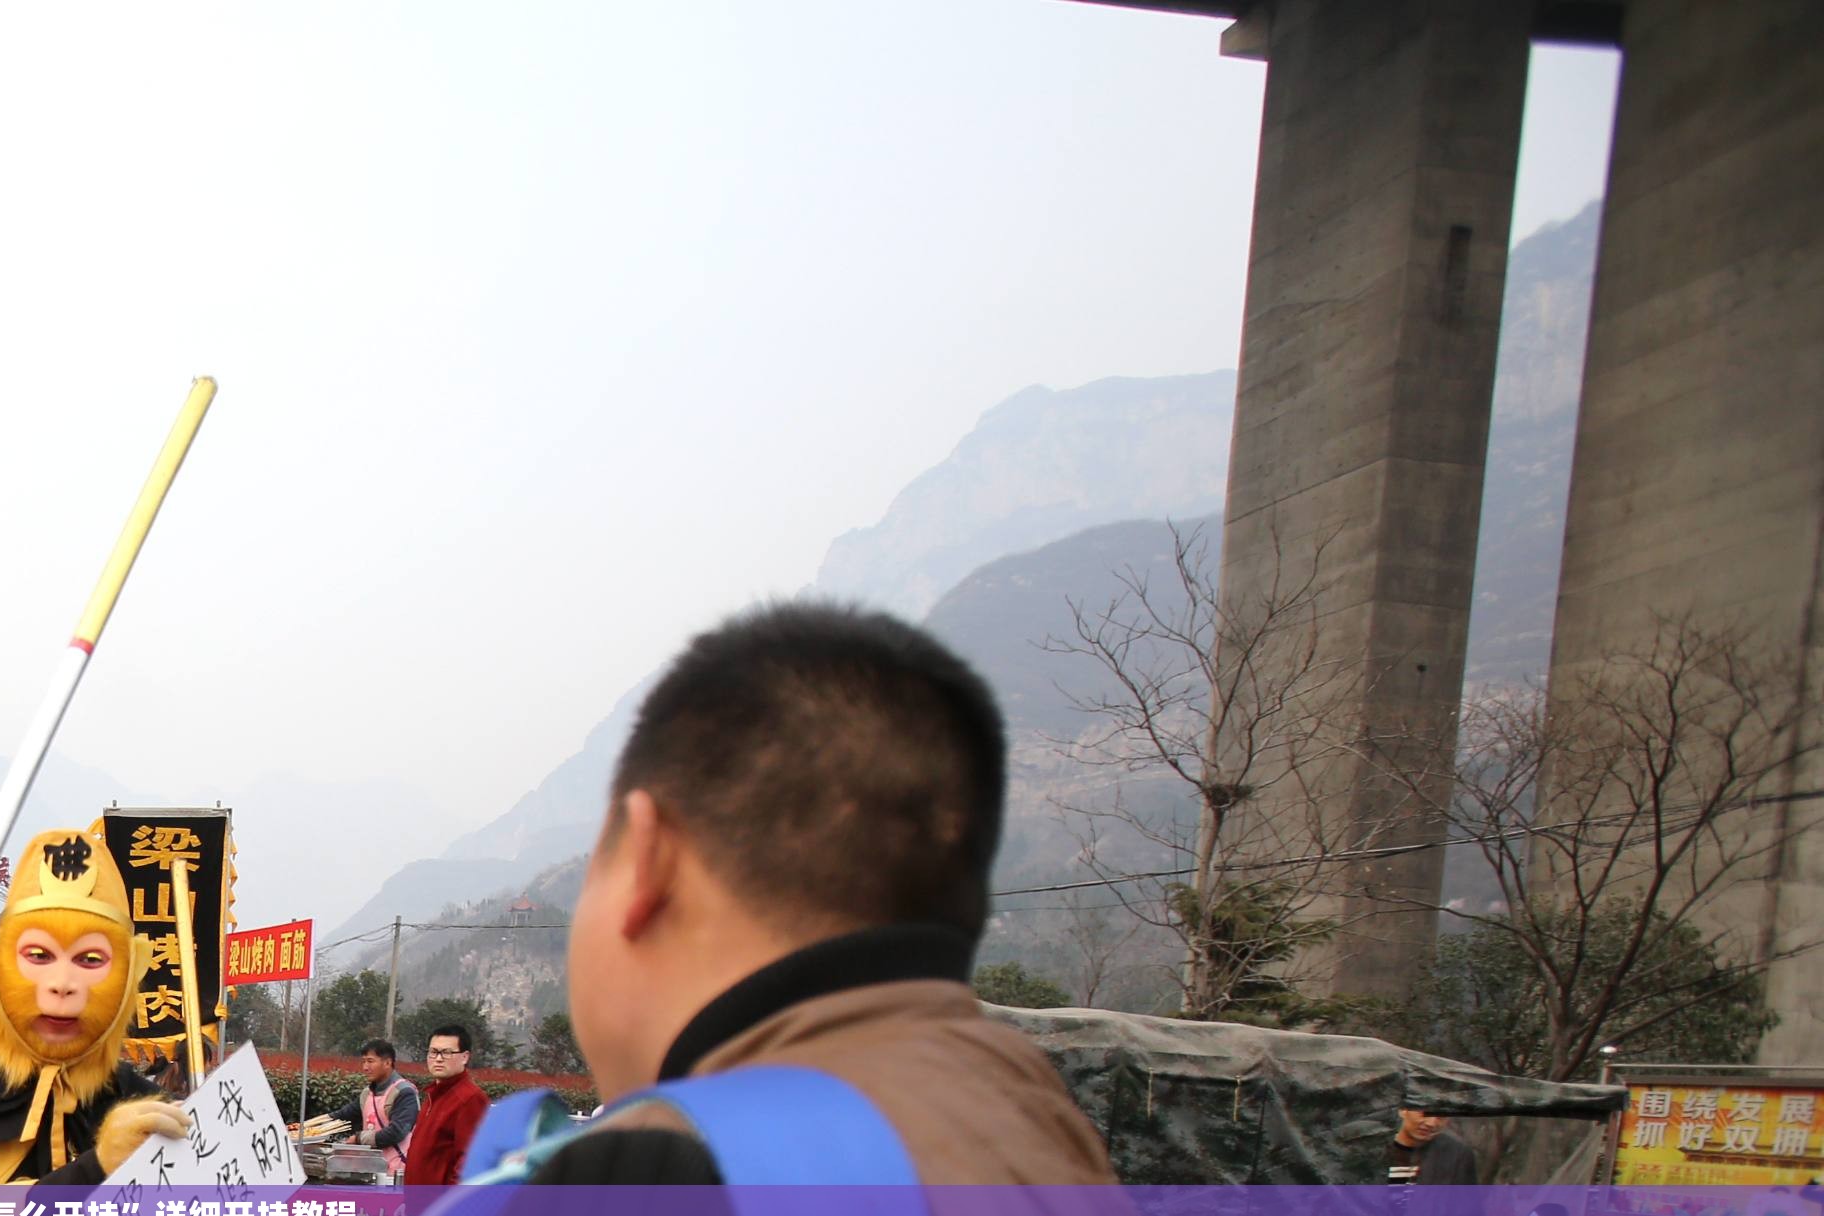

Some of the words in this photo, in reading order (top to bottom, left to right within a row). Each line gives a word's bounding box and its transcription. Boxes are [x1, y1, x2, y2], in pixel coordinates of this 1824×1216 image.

[229, 934, 275, 977] 梁山烤肉
[279, 928, 306, 972] 面筋
[1638, 1090, 1816, 1125] 围绕发展
[1634, 1120, 1808, 1156] 抓好双拥
